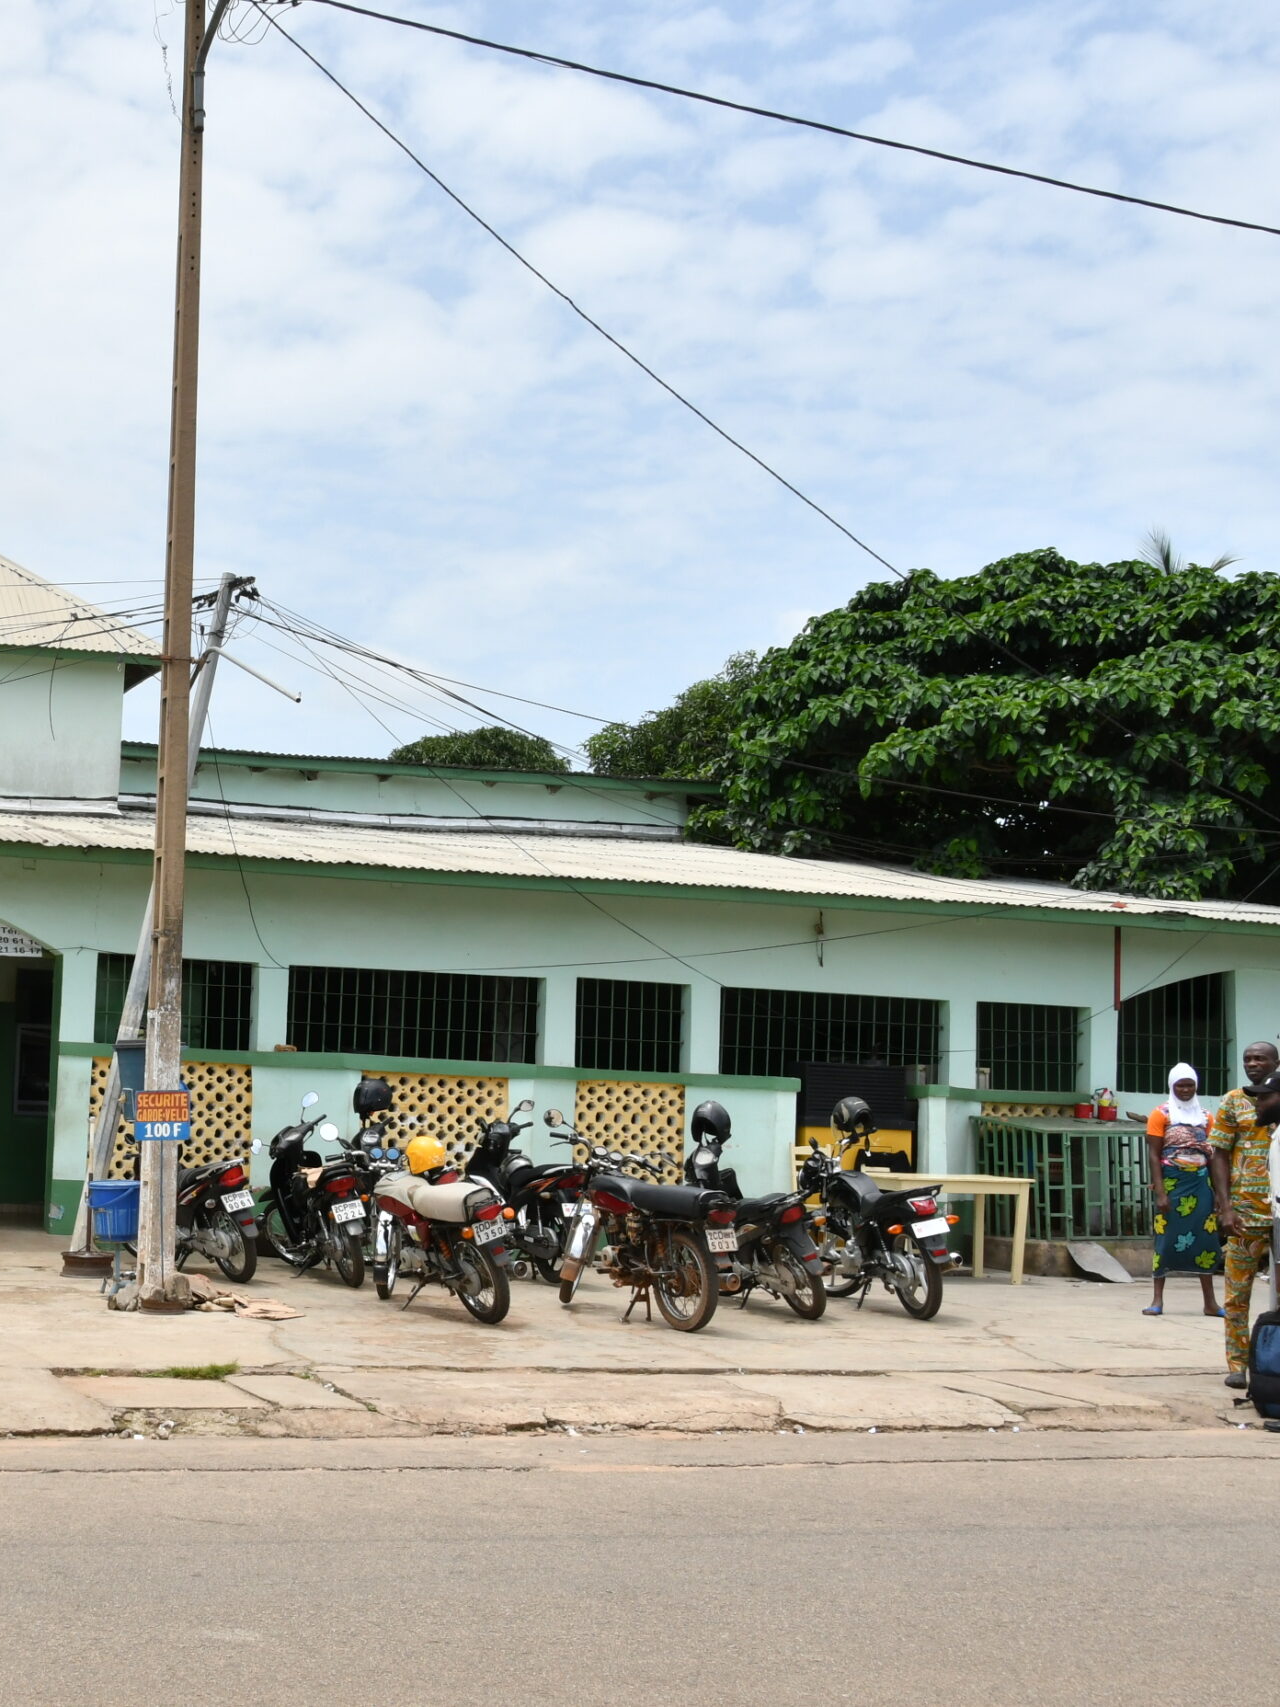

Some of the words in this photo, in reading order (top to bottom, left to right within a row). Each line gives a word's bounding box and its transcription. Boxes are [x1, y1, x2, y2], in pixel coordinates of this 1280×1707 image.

[12, 937, 24, 945] 61
[137, 1093, 188, 1107] SECURITE
[144, 1123, 170, 1137] 100
[173, 1123, 182, 1137] F
